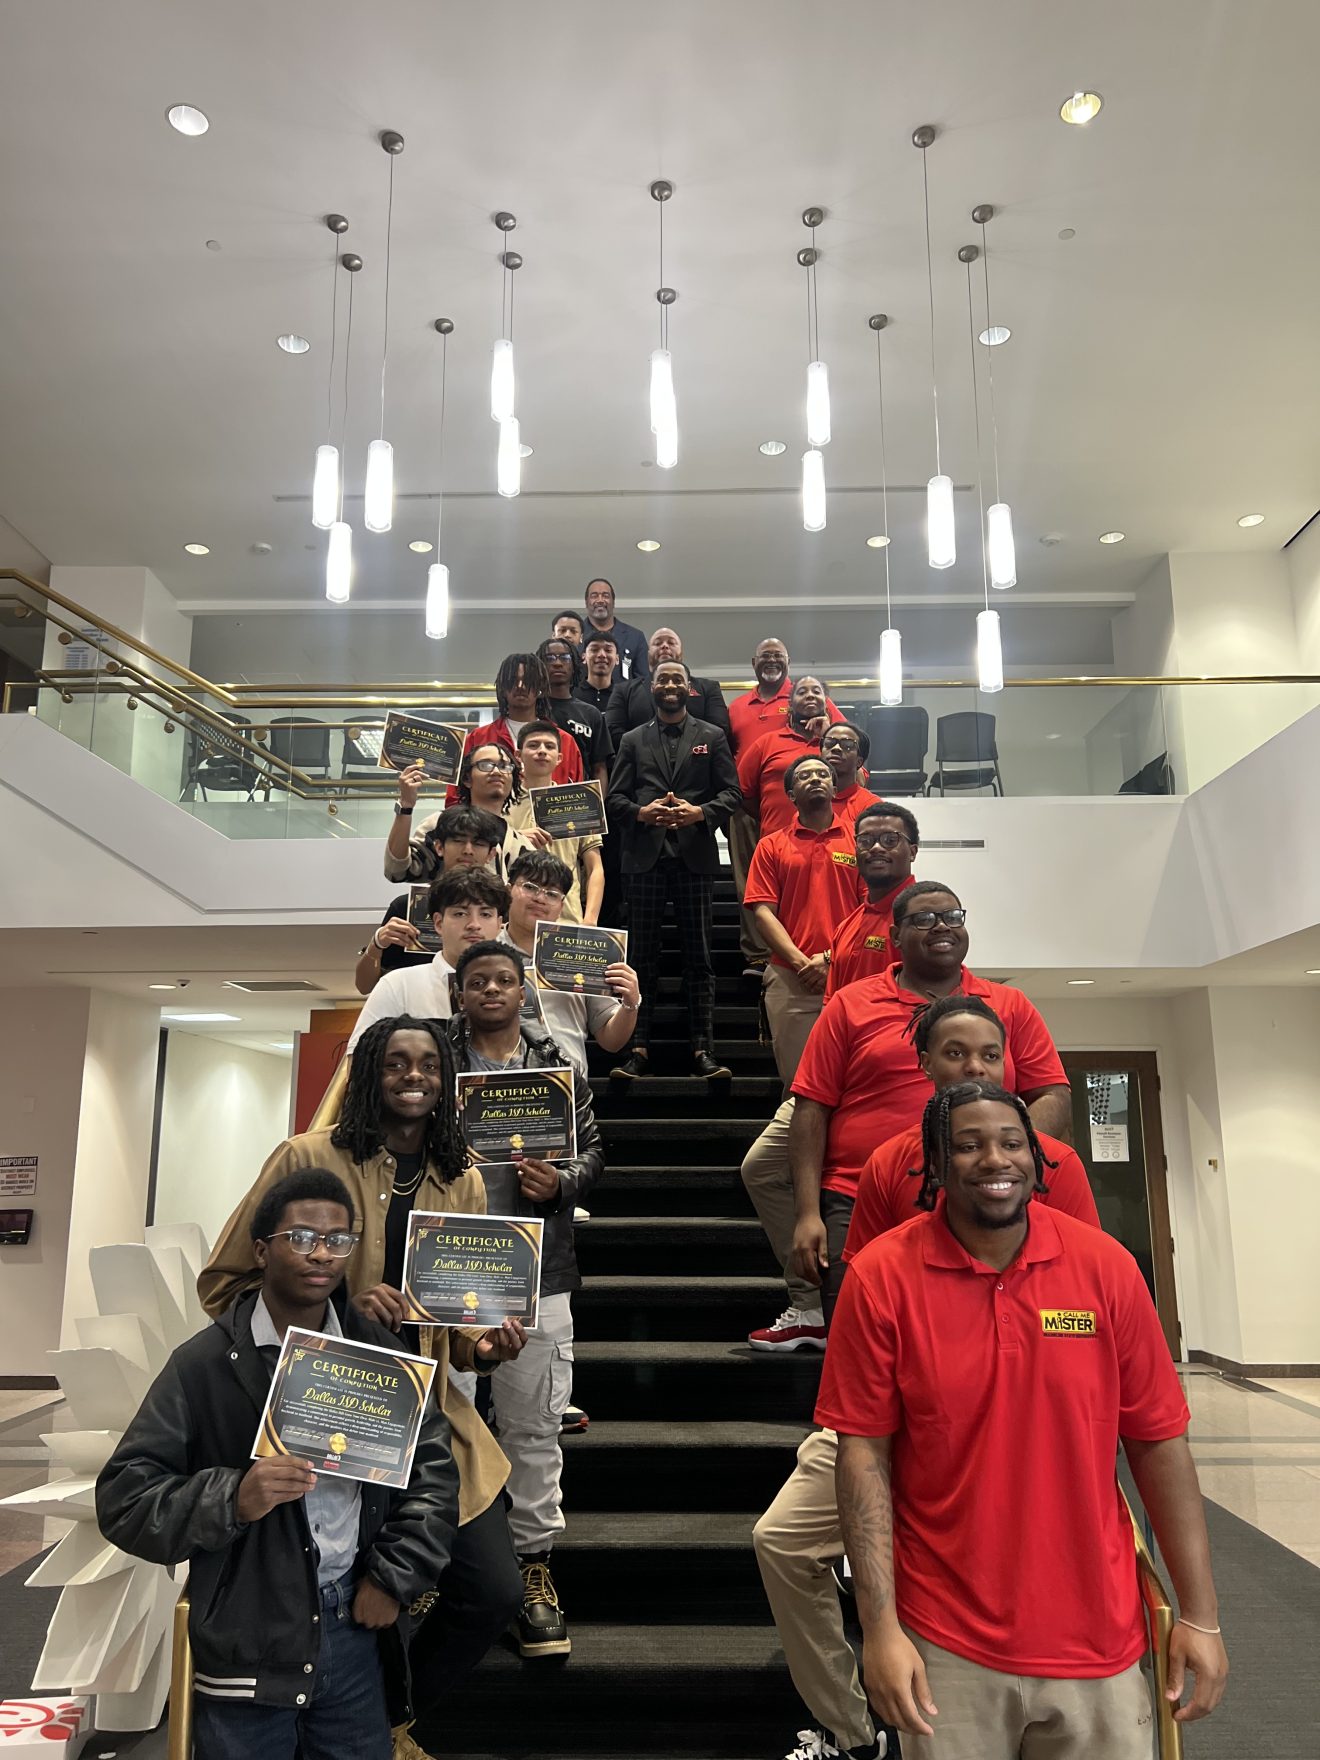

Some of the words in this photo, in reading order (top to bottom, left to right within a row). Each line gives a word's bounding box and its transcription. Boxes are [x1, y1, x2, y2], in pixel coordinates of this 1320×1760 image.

[402, 726, 448, 742] CERTIFICATE
[545, 792, 587, 802] CERTIFICATE
[554, 936, 608, 949] CERTIFICATE
[481, 1086, 550, 1098] CERTIFICATE
[480, 1109, 507, 1119] Dallas
[525, 1107, 551, 1117] Scholar
[0, 1158, 37, 1166] IMPORTANT
[436, 1234, 514, 1249] CERTIFICATE
[432, 1258, 463, 1269] Dallas
[463, 1260, 483, 1271] ISD
[483, 1261, 513, 1272] Scholar
[312, 1360, 399, 1388] CERTIFICATE
[302, 1387, 337, 1404] Dallas
[337, 1394, 359, 1409] ISD
[359, 1399, 392, 1417] Scholar
